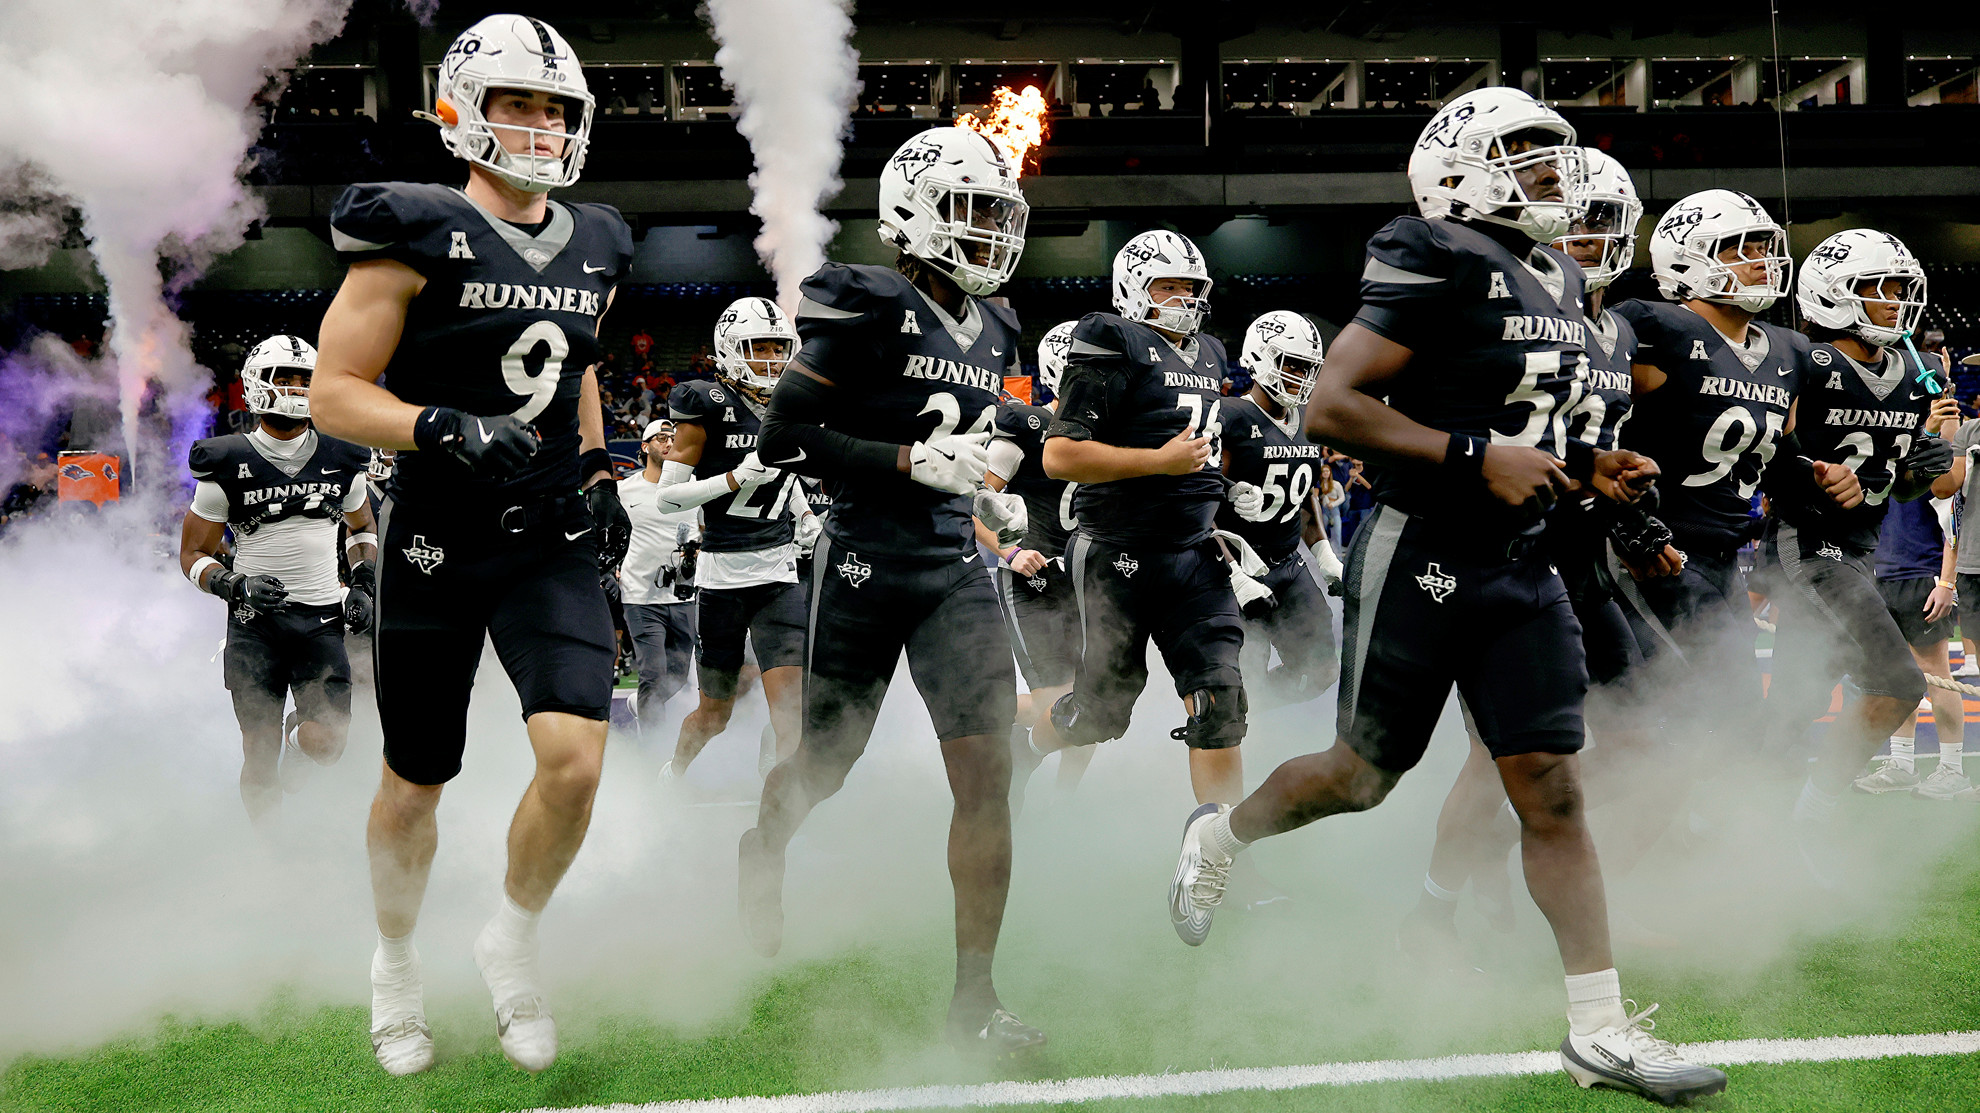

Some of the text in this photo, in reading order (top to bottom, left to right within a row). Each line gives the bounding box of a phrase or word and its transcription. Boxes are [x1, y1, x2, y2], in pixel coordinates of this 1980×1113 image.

[541, 69, 567, 82] 210
[1424, 106, 1475, 143] 210
[898, 147, 941, 164] 210
[1000, 177, 1017, 190] 210
[1662, 211, 1703, 232] 210
[449, 231, 475, 259] A
[1126, 244, 1152, 261] 210
[1815, 245, 1849, 261] 210
[1488, 271, 1512, 299] A
[460, 282, 600, 316] RUNNERS
[900, 309, 922, 335] A
[1258, 321, 1285, 334] 210
[1502, 315, 1587, 349] RUNNE
[1689, 339, 1712, 361] A
[501, 320, 569, 424] 9
[1825, 371, 1844, 390] A
[1699, 375, 1790, 410] RUNNERS
[1262, 445, 1320, 459] RUNNERS
[1681, 405, 1785, 499] 95
[243, 483, 341, 506] RUNNERS
[1252, 463, 1313, 524] 59
[409, 547, 445, 562] 210
[841, 563, 872, 577] 210
[1422, 574, 1457, 591] 210
